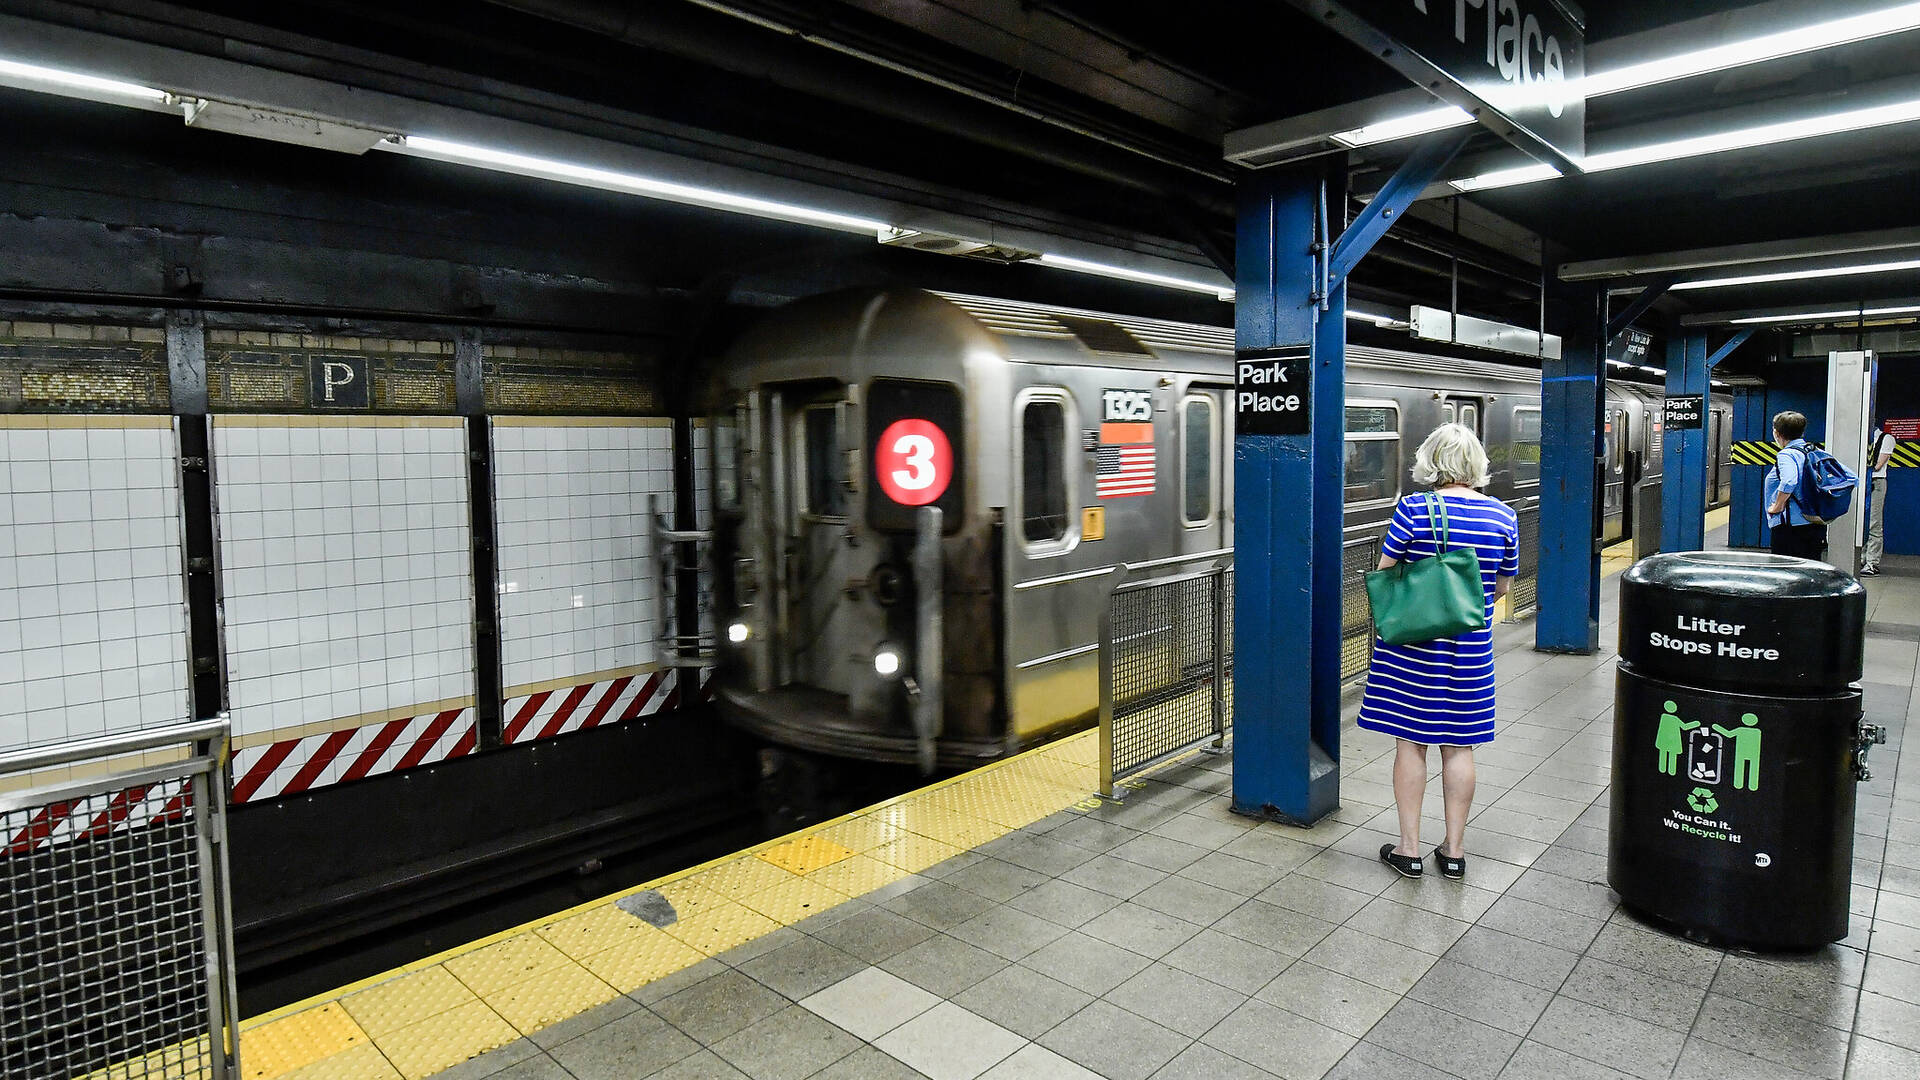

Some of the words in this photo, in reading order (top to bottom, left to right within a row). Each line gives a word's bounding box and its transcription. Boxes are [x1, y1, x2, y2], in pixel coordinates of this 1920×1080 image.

[323, 362, 354, 401] P
[1239, 362, 1288, 384] Park
[1103, 391, 1152, 421] 1325
[1238, 392, 1300, 412] Place
[1666, 400, 1692, 409] Park
[1666, 411, 1698, 421] Place
[892, 434, 936, 490] 3
[1677, 615, 1746, 636] Litter
[1650, 632, 1712, 654] Stops
[1718, 641, 1780, 661] Here
[1663, 818, 1679, 830] We
[1681, 823, 1727, 841] Recycle
[1672, 809, 1692, 822] You
[1694, 816, 1717, 828] Can
